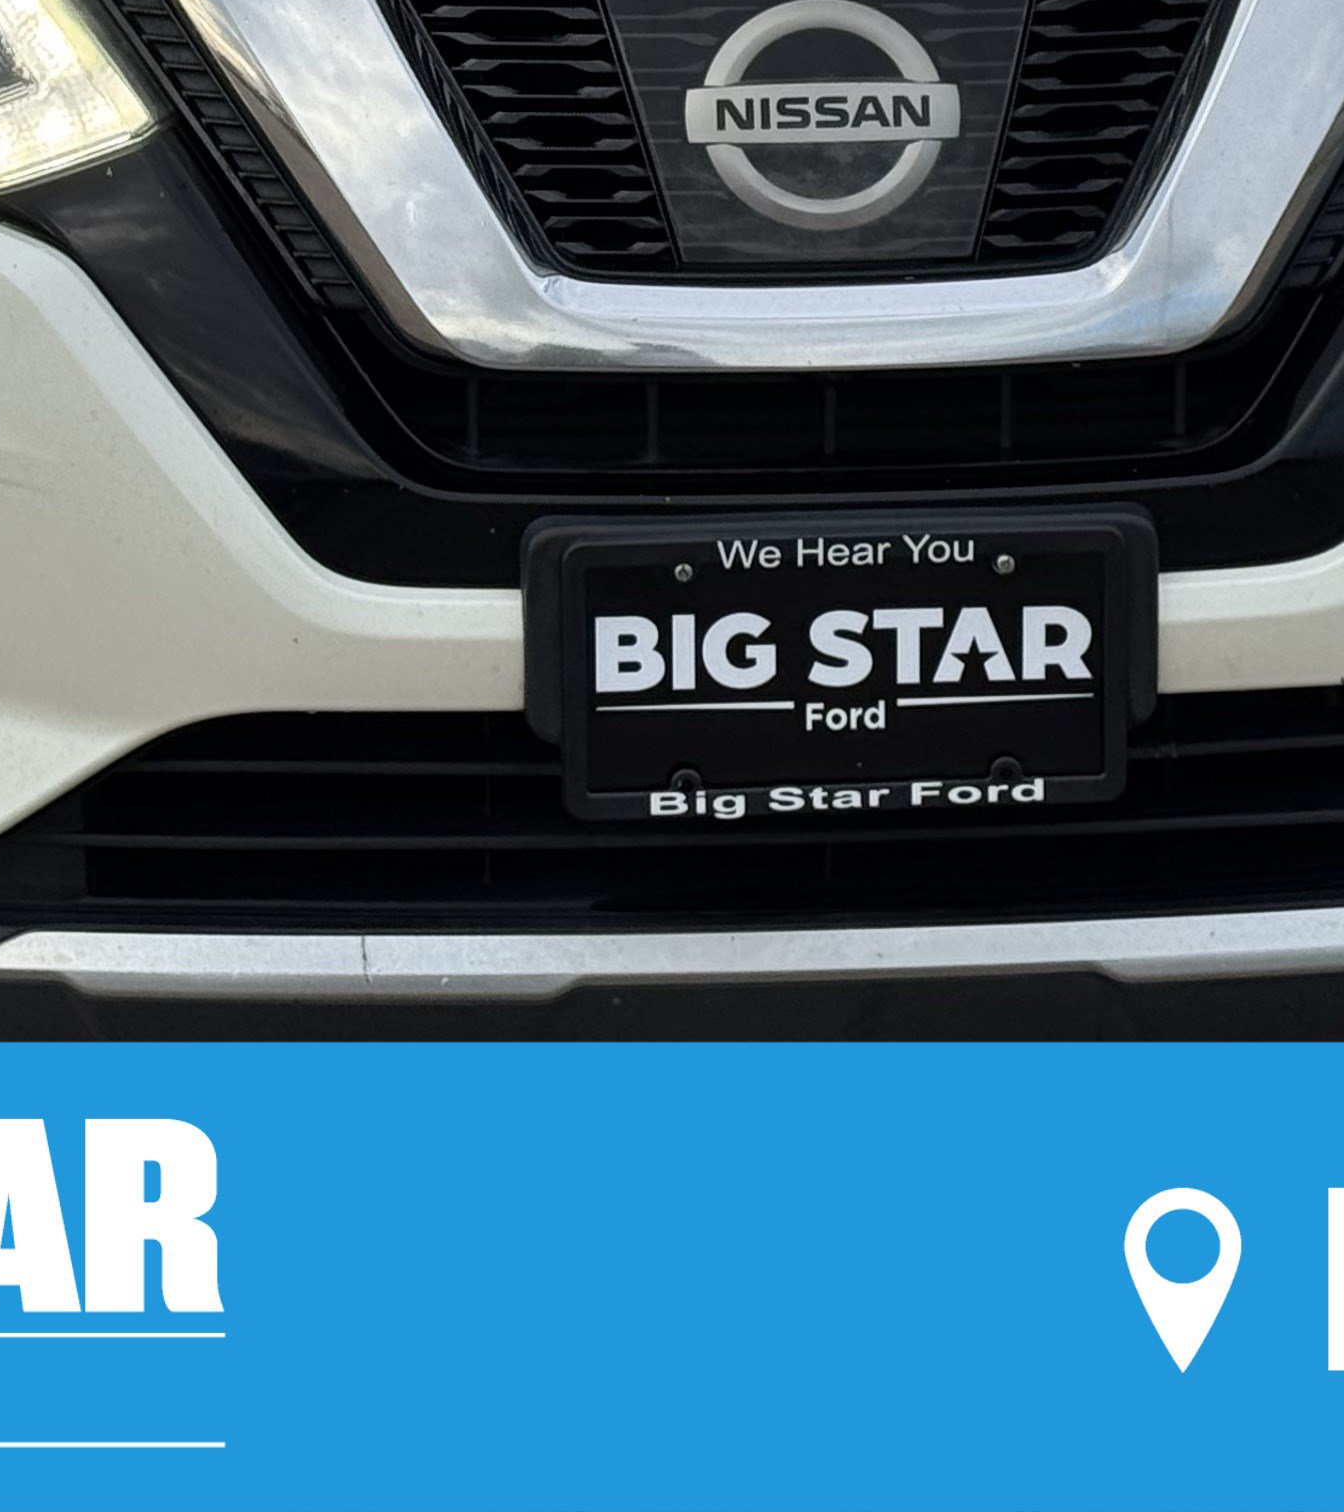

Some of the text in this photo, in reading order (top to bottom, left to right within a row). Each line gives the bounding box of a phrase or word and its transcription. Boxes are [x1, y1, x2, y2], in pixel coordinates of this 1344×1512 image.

[716, 94, 931, 131] NISSAN
[716, 533, 975, 569] We Hear You
[594, 605, 1093, 693] BIG STAR
[805, 700, 887, 731] Ford
[649, 777, 1045, 820] Big Star Ford
